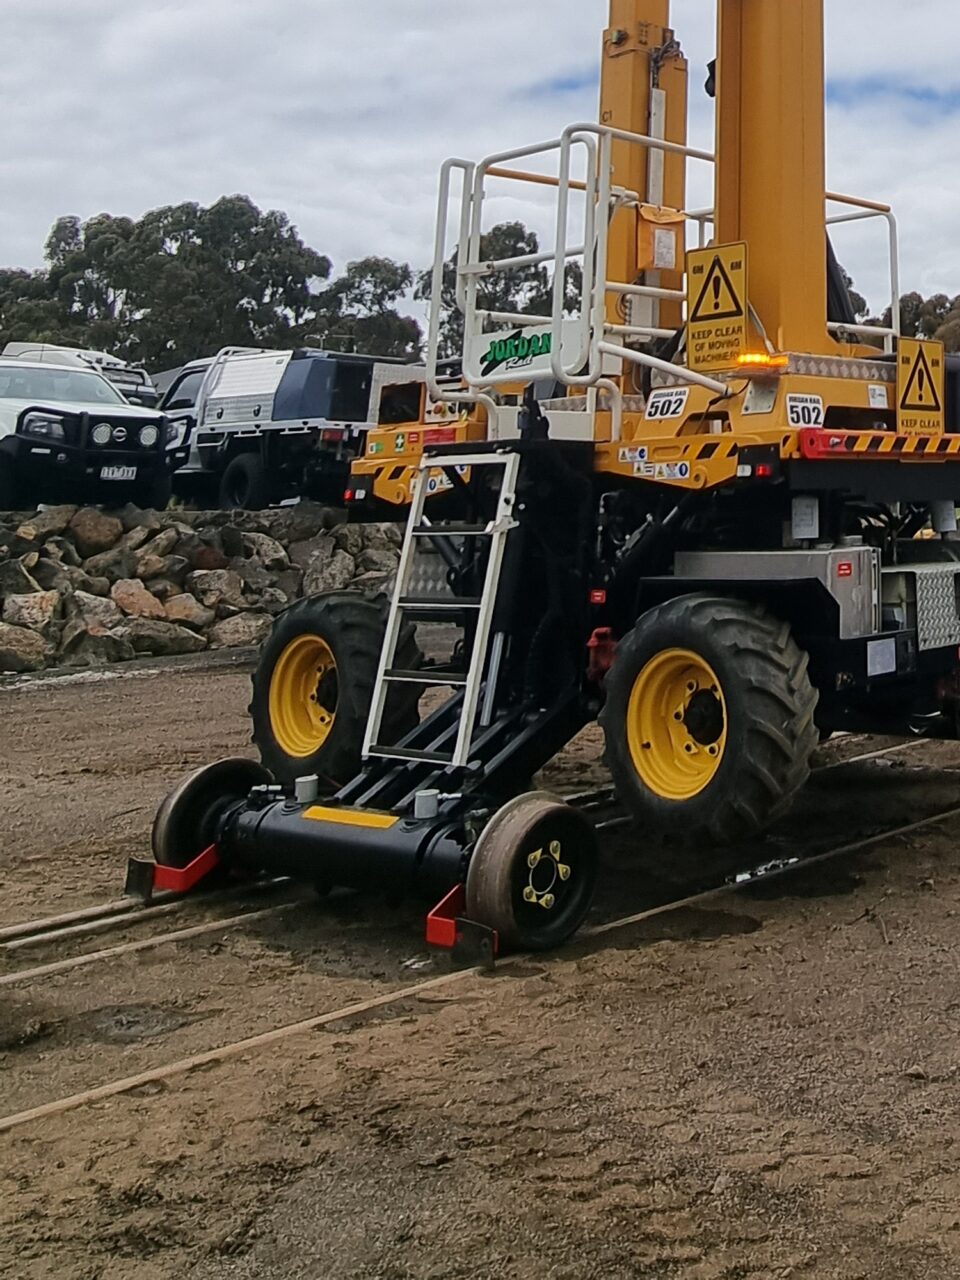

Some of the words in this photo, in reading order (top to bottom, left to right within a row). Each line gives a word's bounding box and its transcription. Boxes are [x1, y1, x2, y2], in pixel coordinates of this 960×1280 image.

[691, 329, 713, 340] KEEP
[714, 324, 743, 338] CLEAR
[486, 332, 552, 362] JORDAN
[694, 341, 706, 352] OF
[708, 337, 740, 351] MOVING
[647, 398, 684, 418] 502
[789, 404, 822, 426] 502
[901, 419, 917, 428] KEEP
[919, 419, 940, 429] CLEAR
